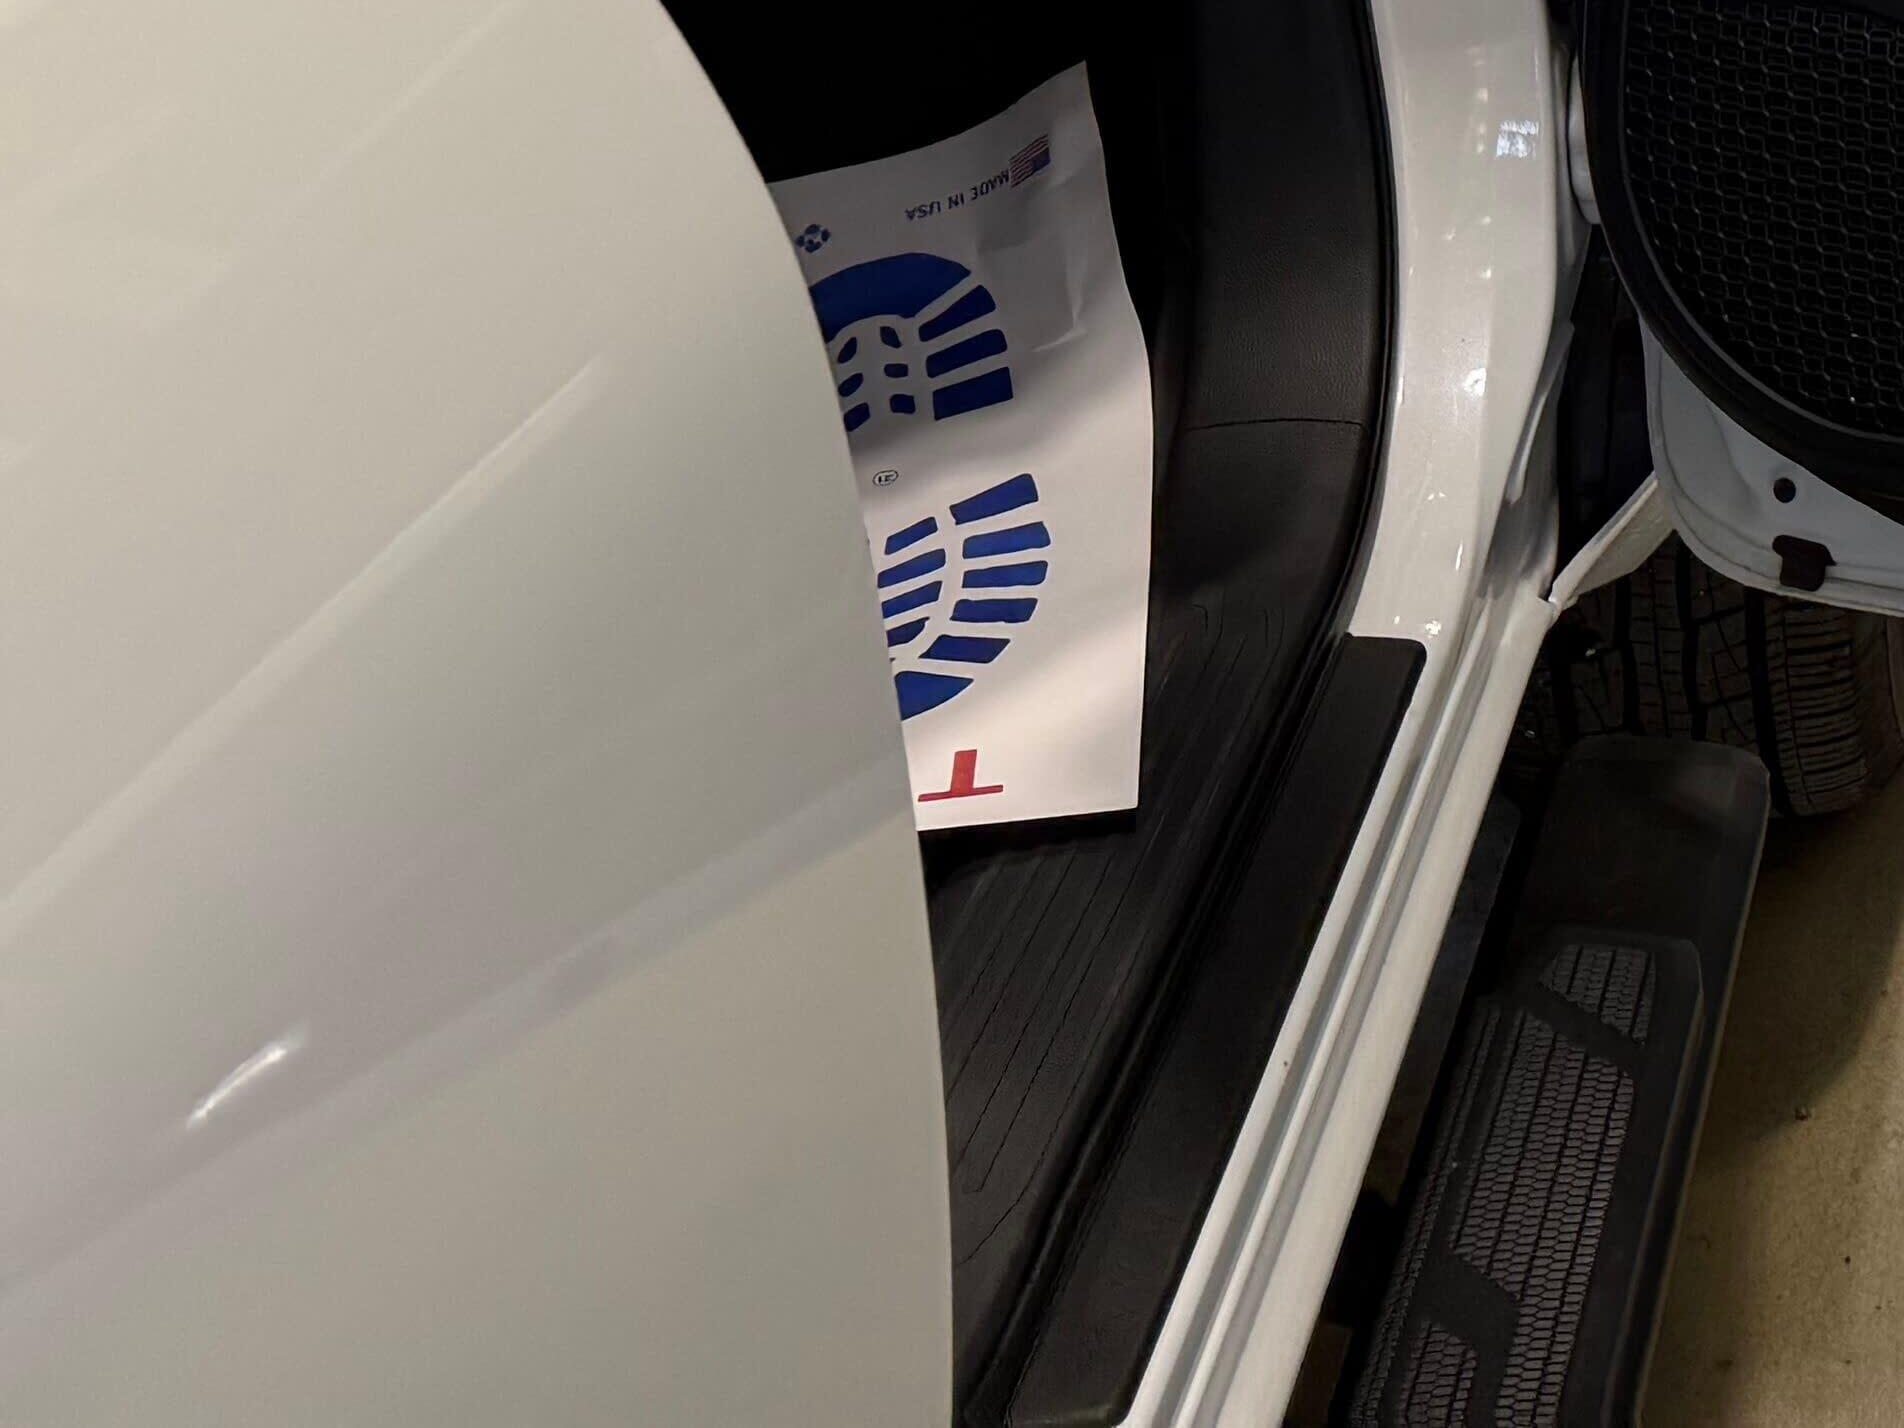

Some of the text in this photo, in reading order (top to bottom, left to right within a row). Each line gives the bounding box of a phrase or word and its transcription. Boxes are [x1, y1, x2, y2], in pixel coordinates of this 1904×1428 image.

[905, 169, 1010, 221] MADE IN USA
